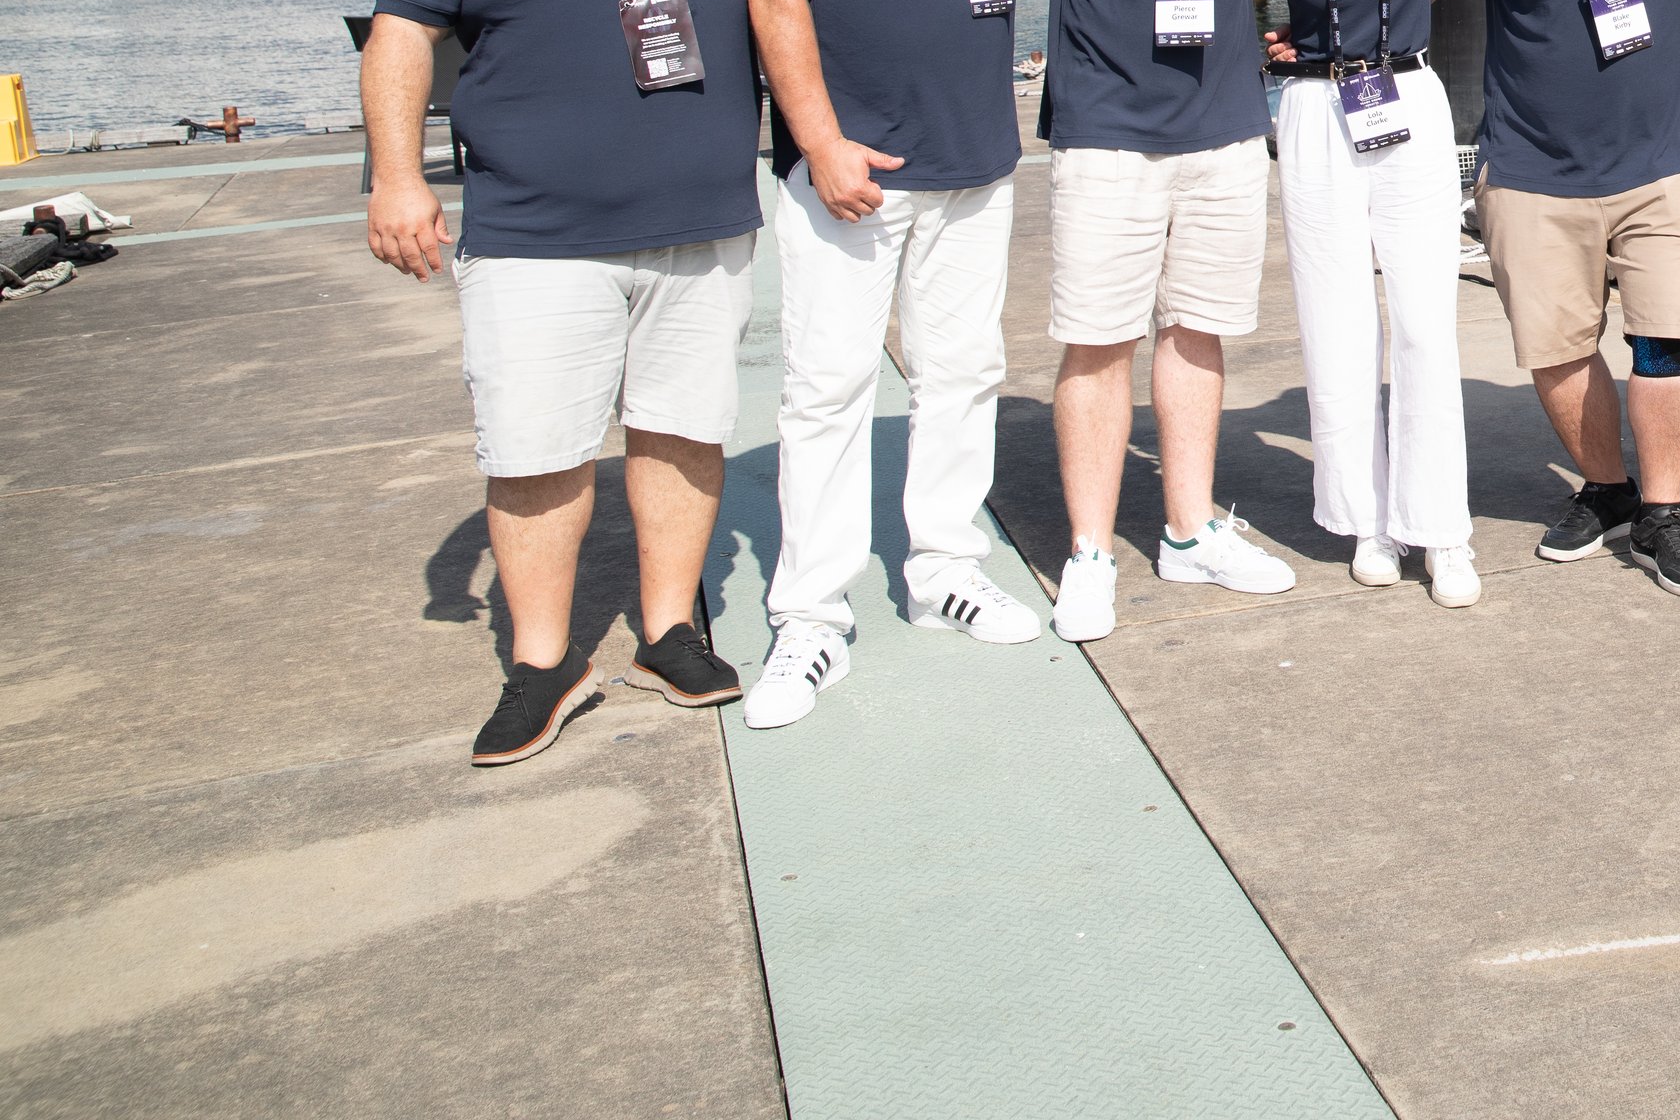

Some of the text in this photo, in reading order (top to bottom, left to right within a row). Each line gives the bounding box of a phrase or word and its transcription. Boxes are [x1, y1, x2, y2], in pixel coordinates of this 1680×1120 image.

[1612, 13, 1630, 22] Blake
[1614, 21, 1632, 30] Kirby
[1368, 111, 1383, 119] Lola
[1366, 117, 1388, 127] Clarke
